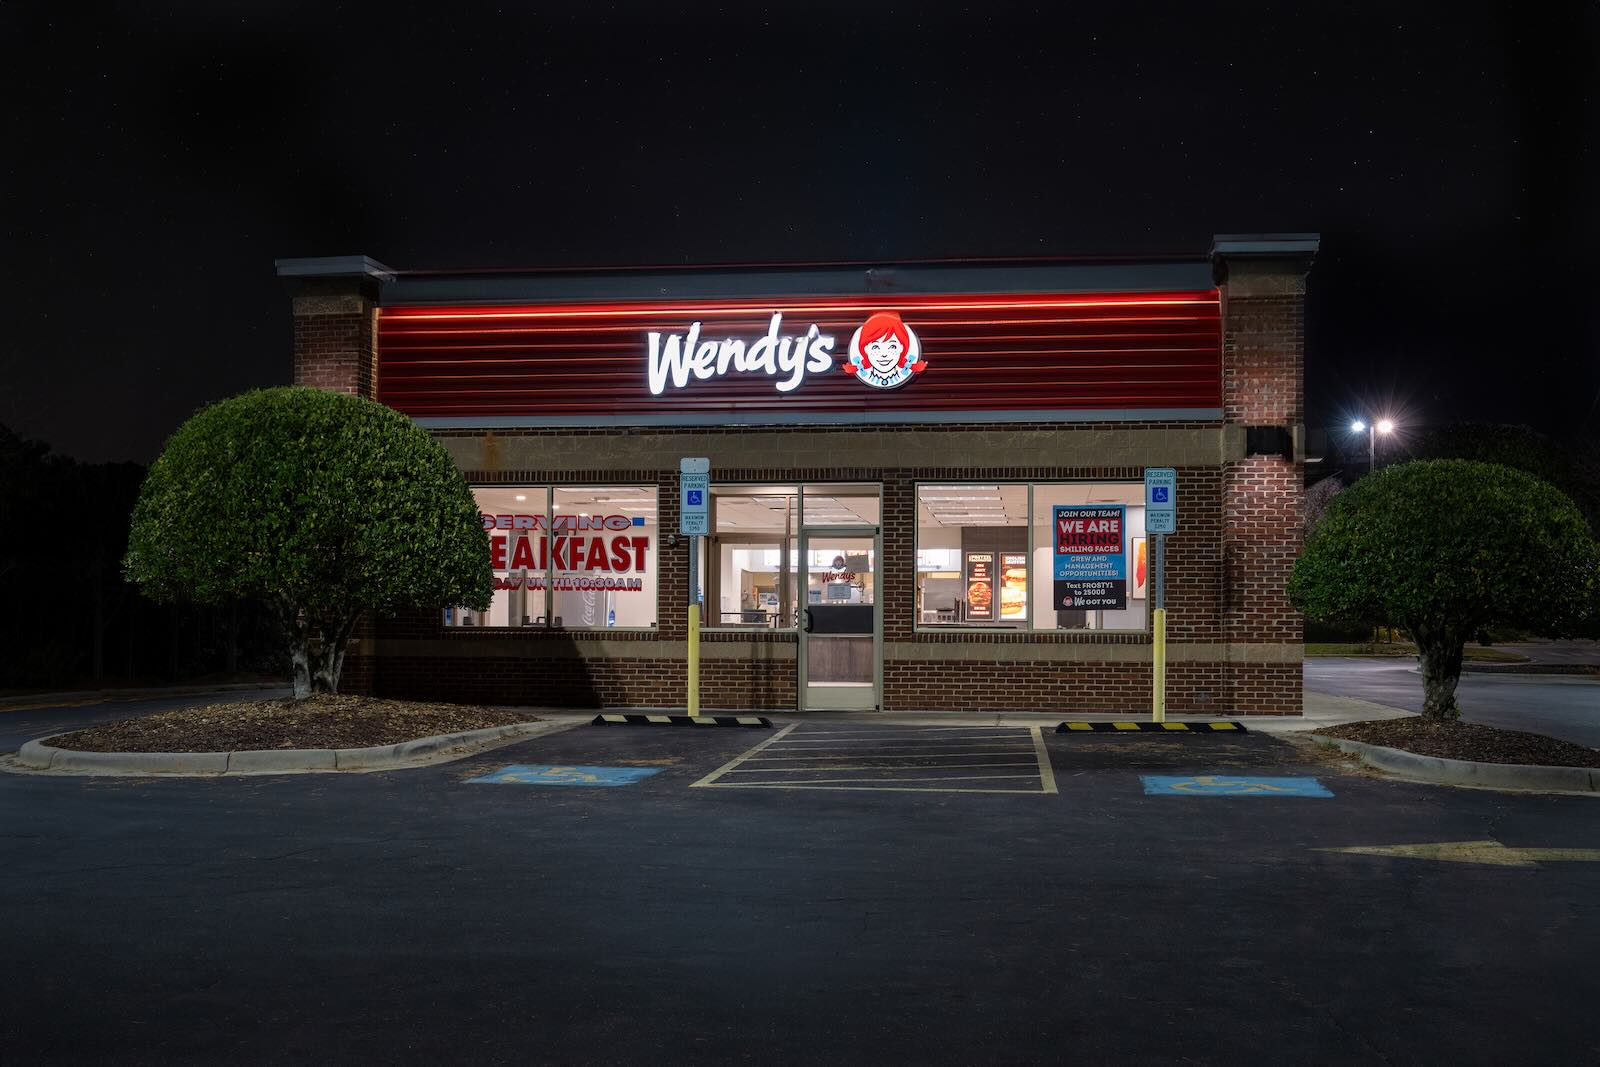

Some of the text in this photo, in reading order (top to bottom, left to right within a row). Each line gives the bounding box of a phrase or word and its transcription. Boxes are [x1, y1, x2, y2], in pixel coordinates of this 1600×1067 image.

[648, 311, 834, 395] Wendy's
[481, 514, 631, 531] SERVING
[1060, 520, 1119, 533] WE ARE
[1060, 533, 1119, 545] HIRING
[822, 571, 856, 583] Wendy's
[1074, 596, 1085, 607] We
